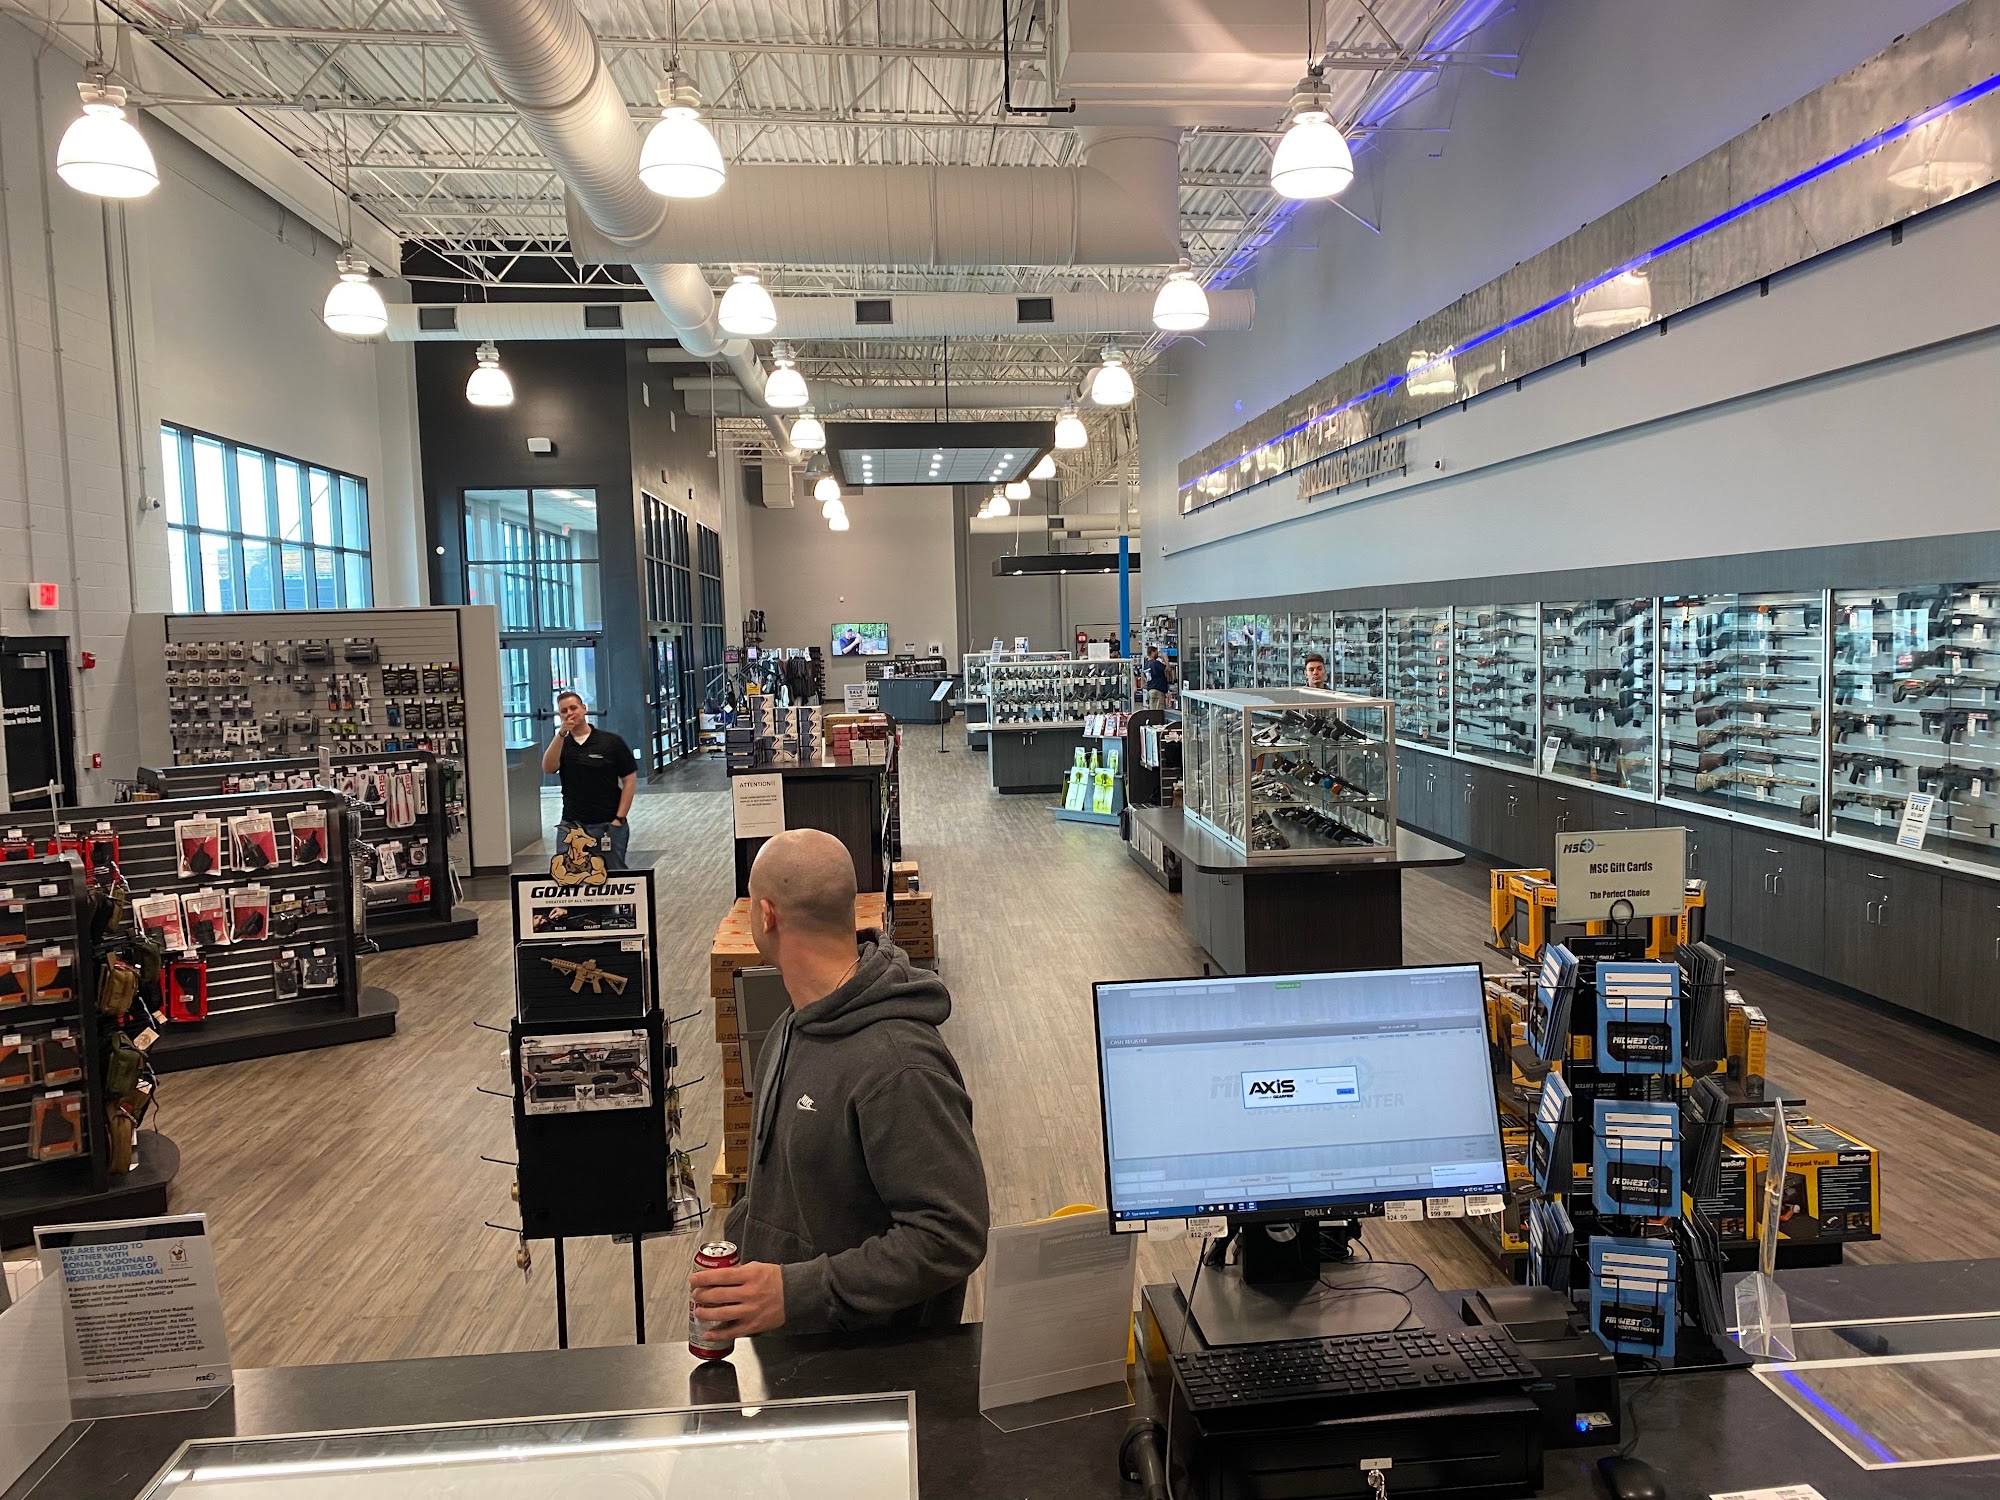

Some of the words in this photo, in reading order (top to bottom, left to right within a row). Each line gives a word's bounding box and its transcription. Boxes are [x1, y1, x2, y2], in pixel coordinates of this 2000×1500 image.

[30, 704, 40, 712] Exit
[1911, 803, 1926, 812] SALE
[1590, 863, 1608, 874] MSC
[1610, 863, 1625, 873] Gift
[1627, 861, 1653, 872] Cards
[531, 885, 582, 898] GOAT
[584, 883, 636, 896] GUNS
[1590, 891, 1601, 899] The
[1602, 890, 1626, 899] Perfect
[1627, 889, 1650, 897] Choice
[1839, 1154, 1870, 1162] SnapSafe
[1304, 1209, 1324, 1217] DELL
[97, 1244, 128, 1253] PROUD
[61, 1253, 103, 1262] PARTNER
[105, 1251, 129, 1259] WITH
[63, 1260, 101, 1269] RONALD
[103, 1256, 153, 1266] McDONALD
[64, 1267, 95, 1276] HOUSE
[97, 1263, 144, 1273] CHARITIES
[66, 1272, 120, 1283] NORTHEAST
[122, 1268, 164, 1278] INDIANA!
